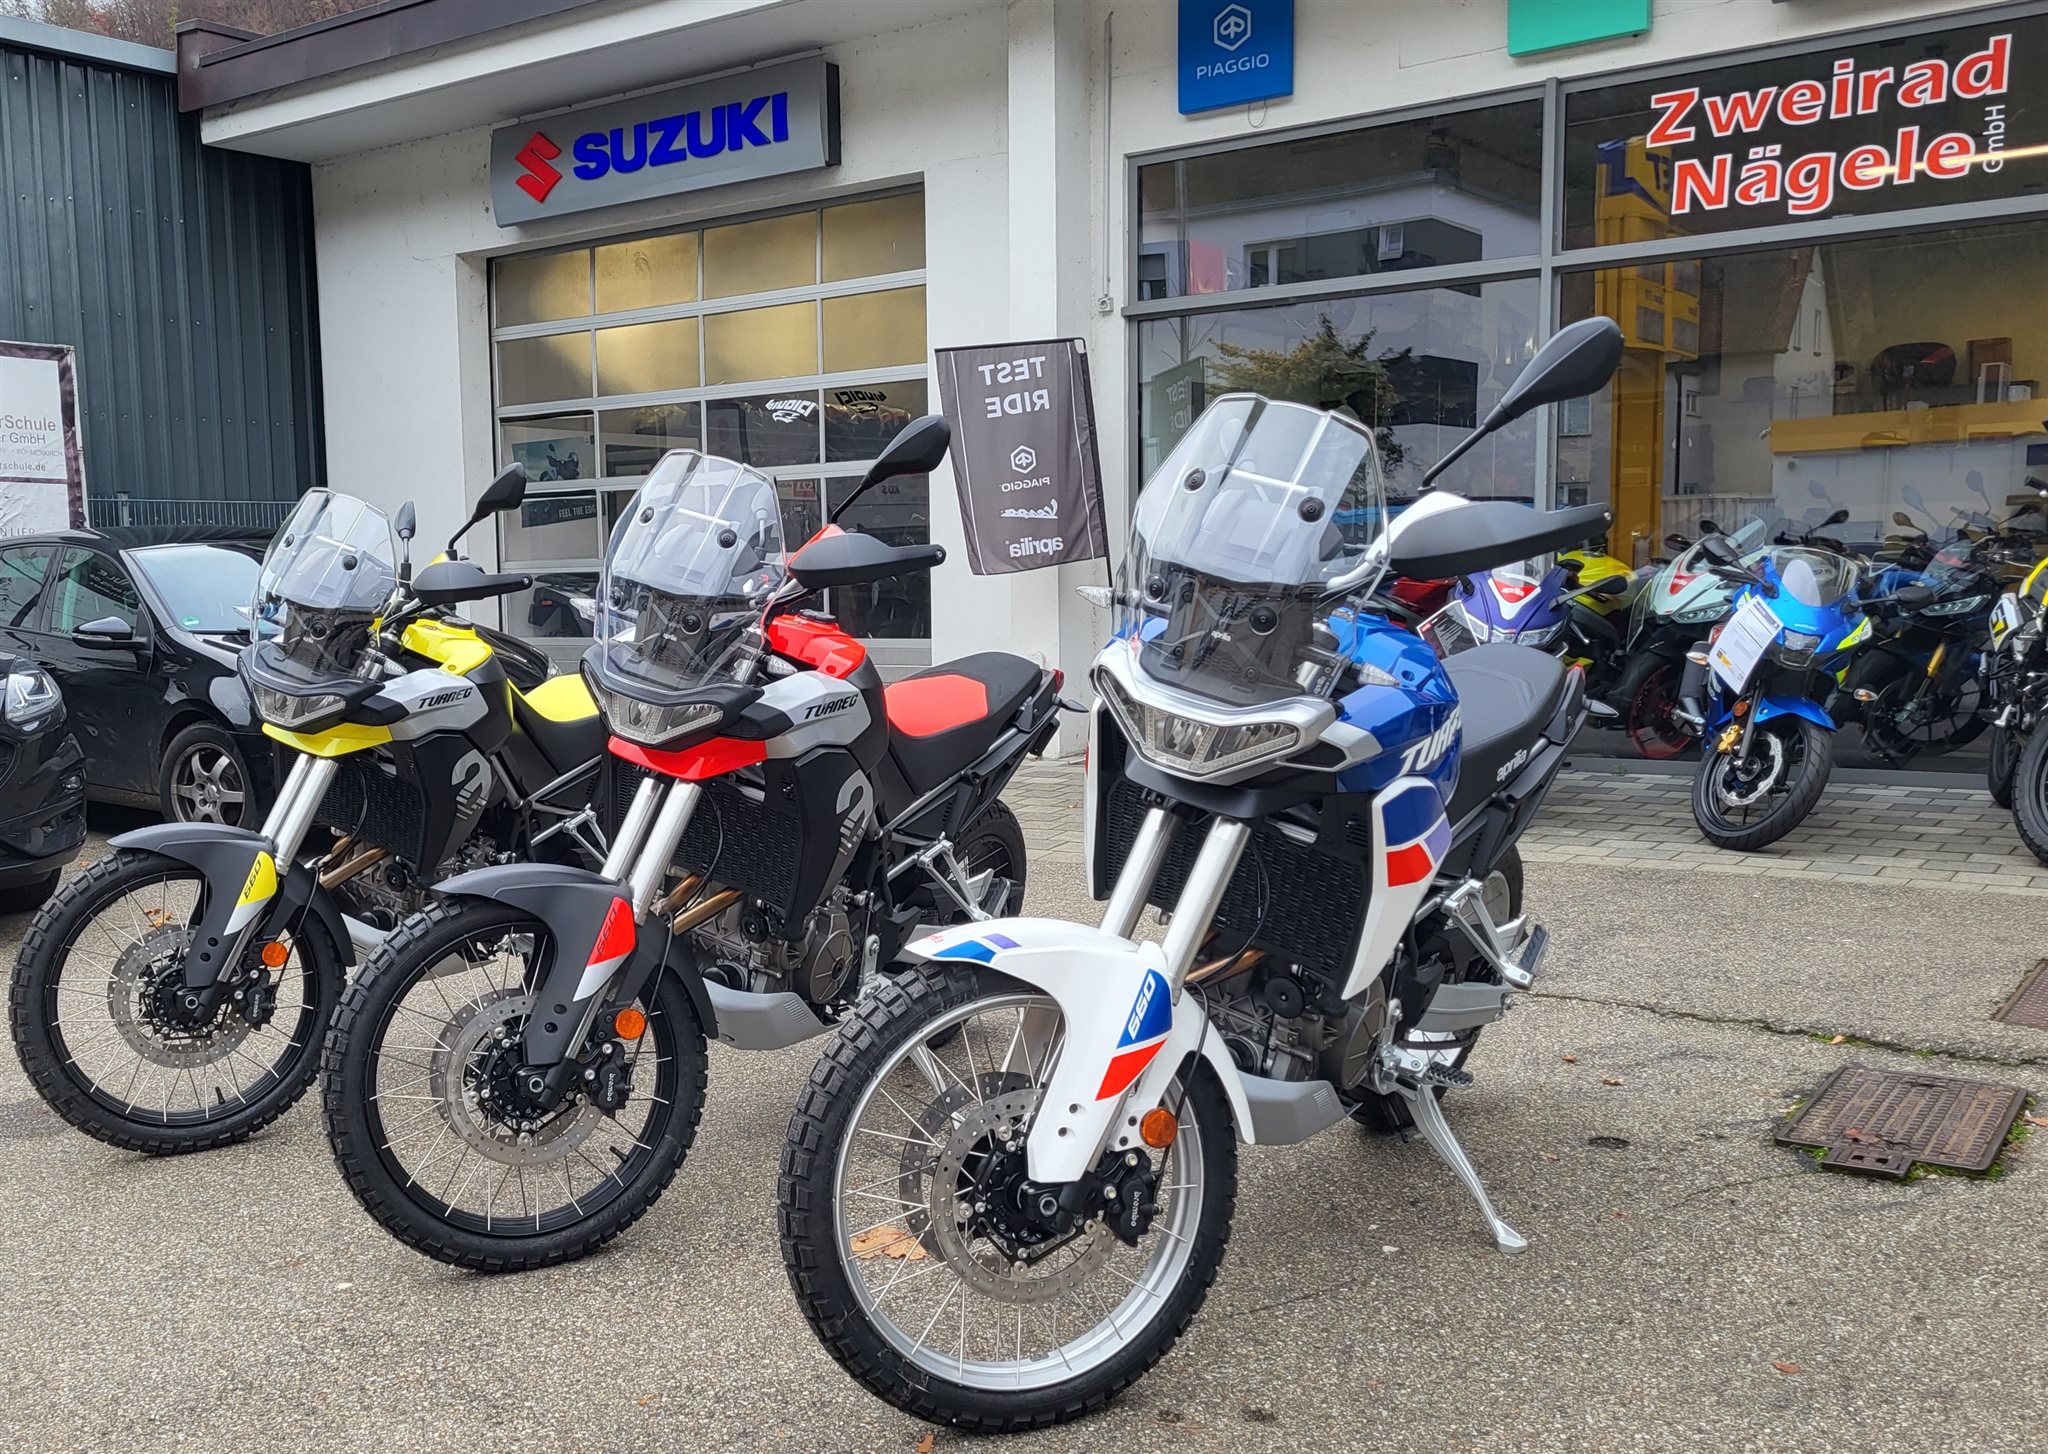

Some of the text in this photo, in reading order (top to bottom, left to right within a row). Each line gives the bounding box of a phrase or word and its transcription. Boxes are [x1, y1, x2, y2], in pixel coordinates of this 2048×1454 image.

[1196, 54, 1269, 80] PIAGGIO
[1646, 34, 2012, 148] Zweirad
[573, 92, 789, 181] SUZUKI
[1982, 104, 2005, 174] GmbH
[1671, 126, 1976, 215] Nägele
[10, 432, 46, 444] GmbH
[559, 509, 572, 518] FEEL
[573, 507, 584, 516] THE
[418, 687, 474, 709] TUAREG
[804, 694, 859, 720] TUAREG
[1497, 749, 1528, 782] aprilia
[244, 859, 261, 900] 660
[597, 907, 617, 956] 660
[1128, 973, 1156, 1041] 660
[606, 1073, 616, 1102] brembo
[1130, 1191, 1142, 1228] brembo
